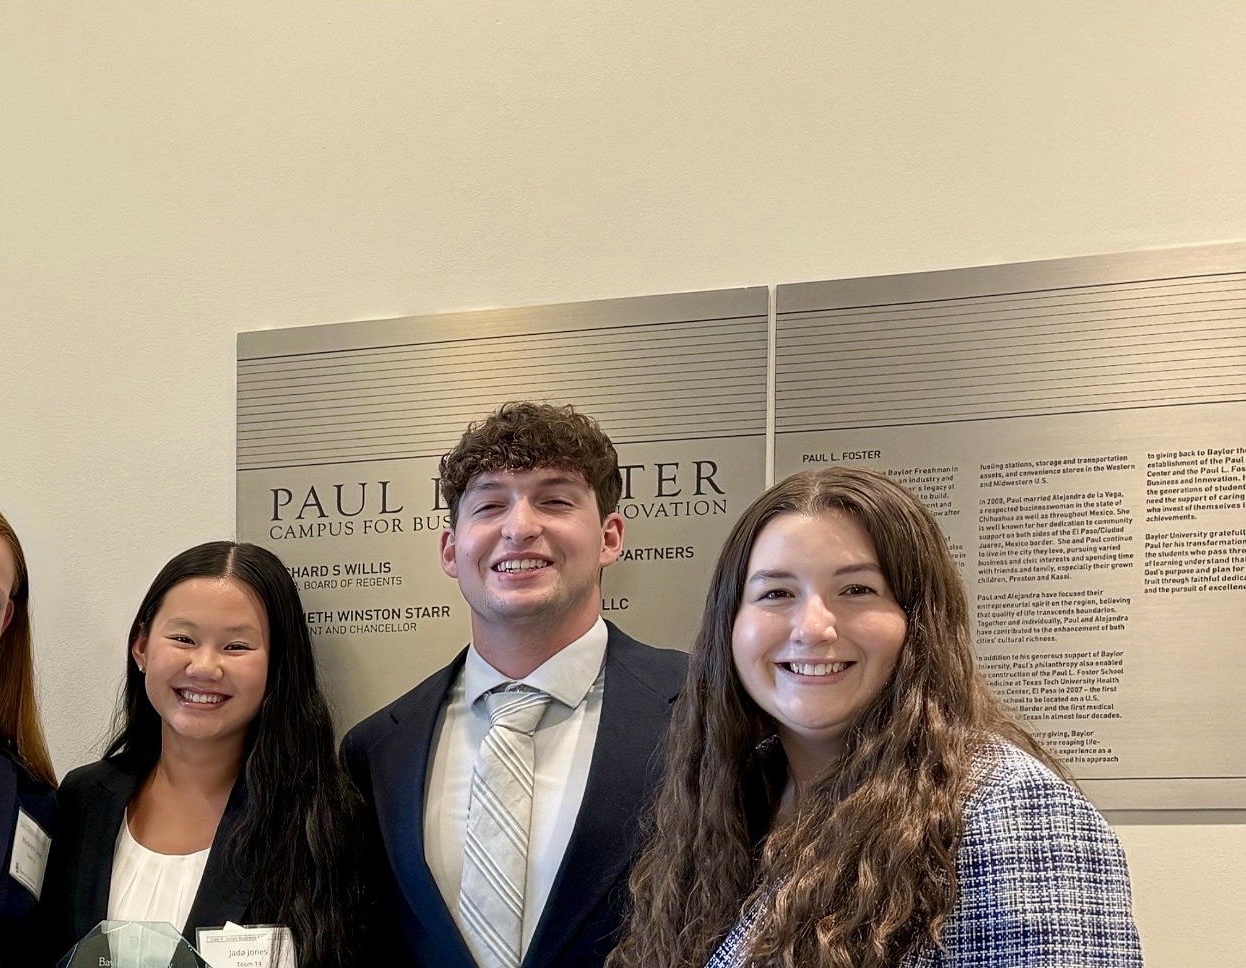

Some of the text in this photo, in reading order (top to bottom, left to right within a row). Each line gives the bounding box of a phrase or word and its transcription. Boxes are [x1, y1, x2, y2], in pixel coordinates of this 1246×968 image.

[803, 450, 881, 462] PAUL L. FOSTER
[980, 463, 1003, 471] fueling
[1005, 461, 1034, 469] stations,
[1077, 455, 1128, 465] transportation
[1148, 459, 1198, 468] establishment
[888, 468, 912, 477] Baylor
[914, 466, 951, 474] Freshman
[980, 471, 1004, 479] assets,
[1019, 468, 1061, 476] convenience
[1172, 468, 1185, 476] and
[909, 476, 940, 484] industry
[993, 479, 1033, 487] Midwestern
[270, 481, 404, 521] PAUL
[618, 460, 726, 499] TER
[269, 521, 354, 540] CAMPUS
[363, 518, 404, 535] FOR
[617, 500, 727, 519] OVATION
[1146, 513, 1197, 522] achievements.
[1208, 549, 1227, 557] pass
[286, 562, 392, 579] CHARD S WILLIS
[304, 579, 338, 590] BOARD
[340, 578, 353, 588] OF
[356, 576, 403, 588] REGENTS
[1171, 585, 1197, 594] pursuit
[601, 598, 629, 611] LLC
[338, 608, 401, 622] WINSTON
[405, 606, 451, 619] STARR
[977, 619, 1006, 628] Together
[1022, 617, 1063, 625] individually,
[1095, 614, 1128, 623] Alejandra
[325, 624, 347, 635] AND
[349, 622, 417, 634] CHANCELLOR
[988, 670, 1030, 678] construction
[1060, 677, 1095, 685] University
[1096, 676, 1119, 684] Health
[1058, 738, 1084, 747] reaping
[1059, 747, 1096, 756] experience
[1087, 756, 1119, 764] approach
[229, 949, 246, 958] Jada
